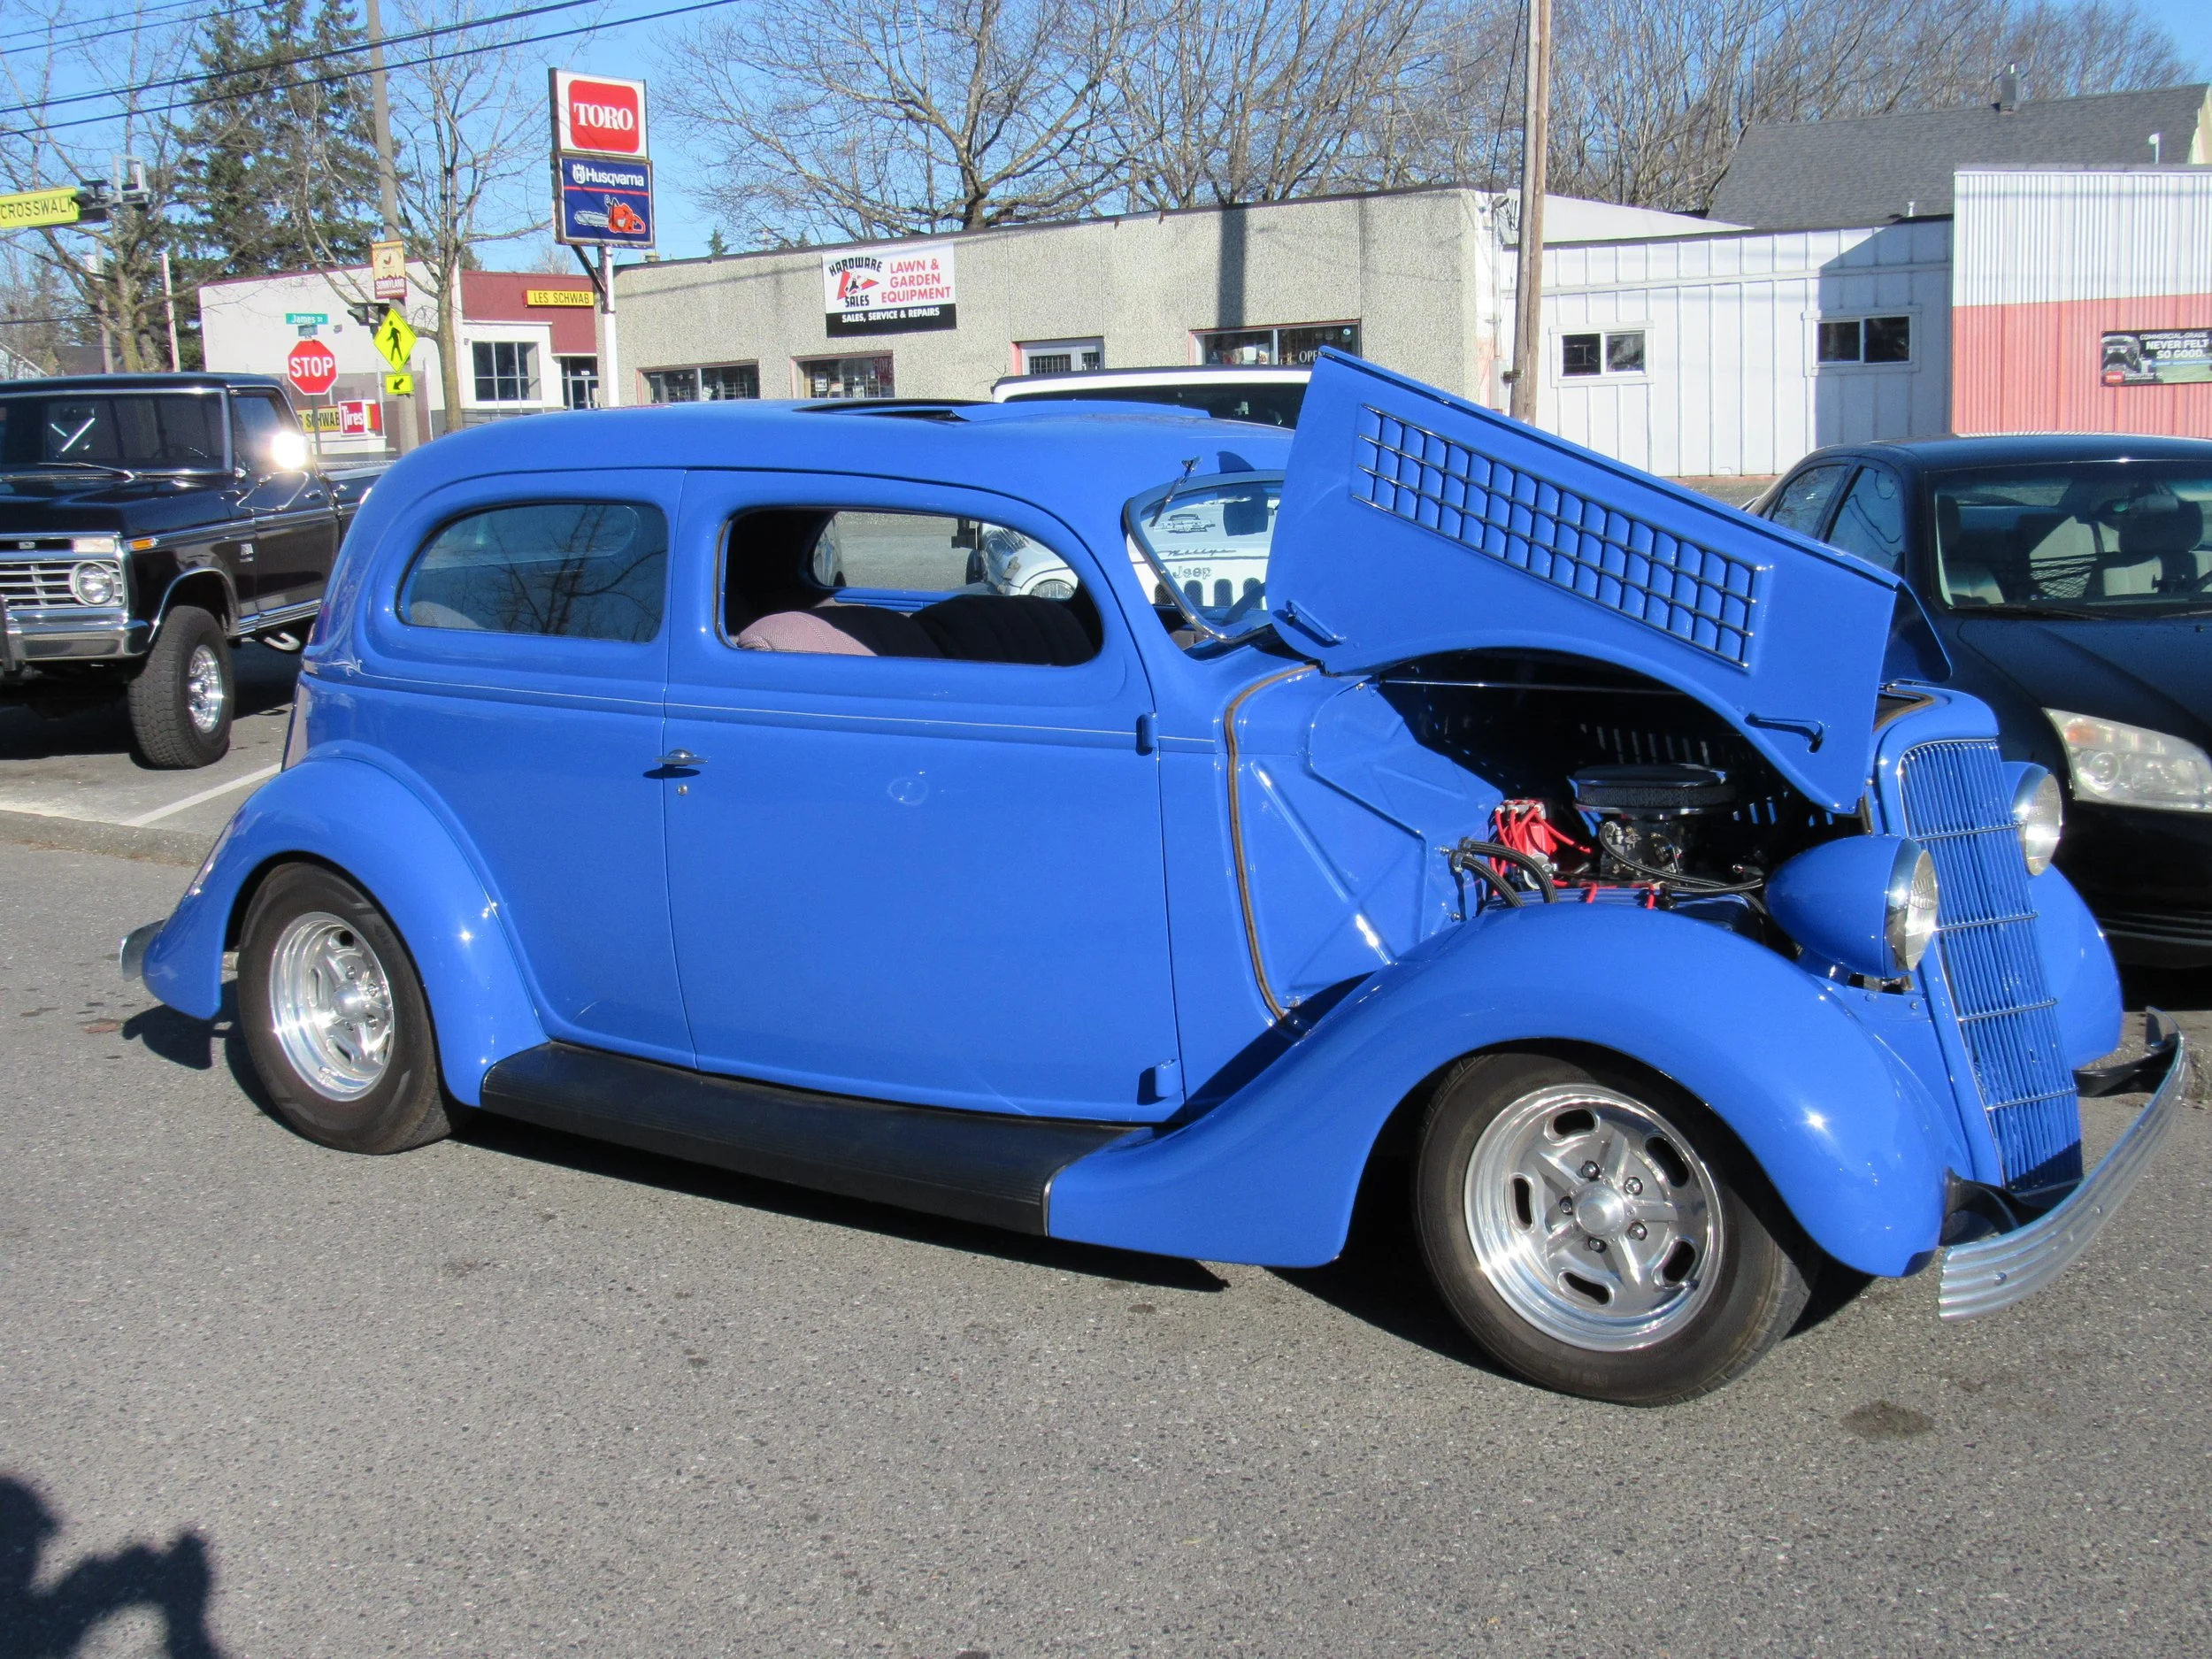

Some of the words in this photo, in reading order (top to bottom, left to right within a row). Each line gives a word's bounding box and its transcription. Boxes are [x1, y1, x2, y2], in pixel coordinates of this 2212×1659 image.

[573, 103, 634, 131] TORO
[586, 167, 644, 187] Husqvarna
[0, 196, 76, 219] CROSSWALK
[829, 257, 882, 276] HARDWARE
[890, 260, 926, 273] LAWN
[931, 258, 940, 270] &
[890, 273, 941, 288] GARDEN
[534, 292, 549, 303] LES
[553, 293, 590, 304] SCHWAB
[845, 295, 870, 308] SALES
[881, 287, 951, 303] EQUIPMENT
[291, 315, 316, 324] James
[842, 312, 866, 323] SALES,
[868, 311, 898, 321] SERVICE
[900, 310, 907, 319] &
[909, 308, 941, 319] REPAIRS
[2146, 340, 2182, 350] NEVER
[2184, 339, 2209, 349] FELT
[2156, 349, 2170, 359] SO
[291, 357, 334, 378] STOP
[305, 411, 341, 428] SHWAB
[342, 405, 364, 430] Tires
[1172, 565, 1211, 580] Jeep
